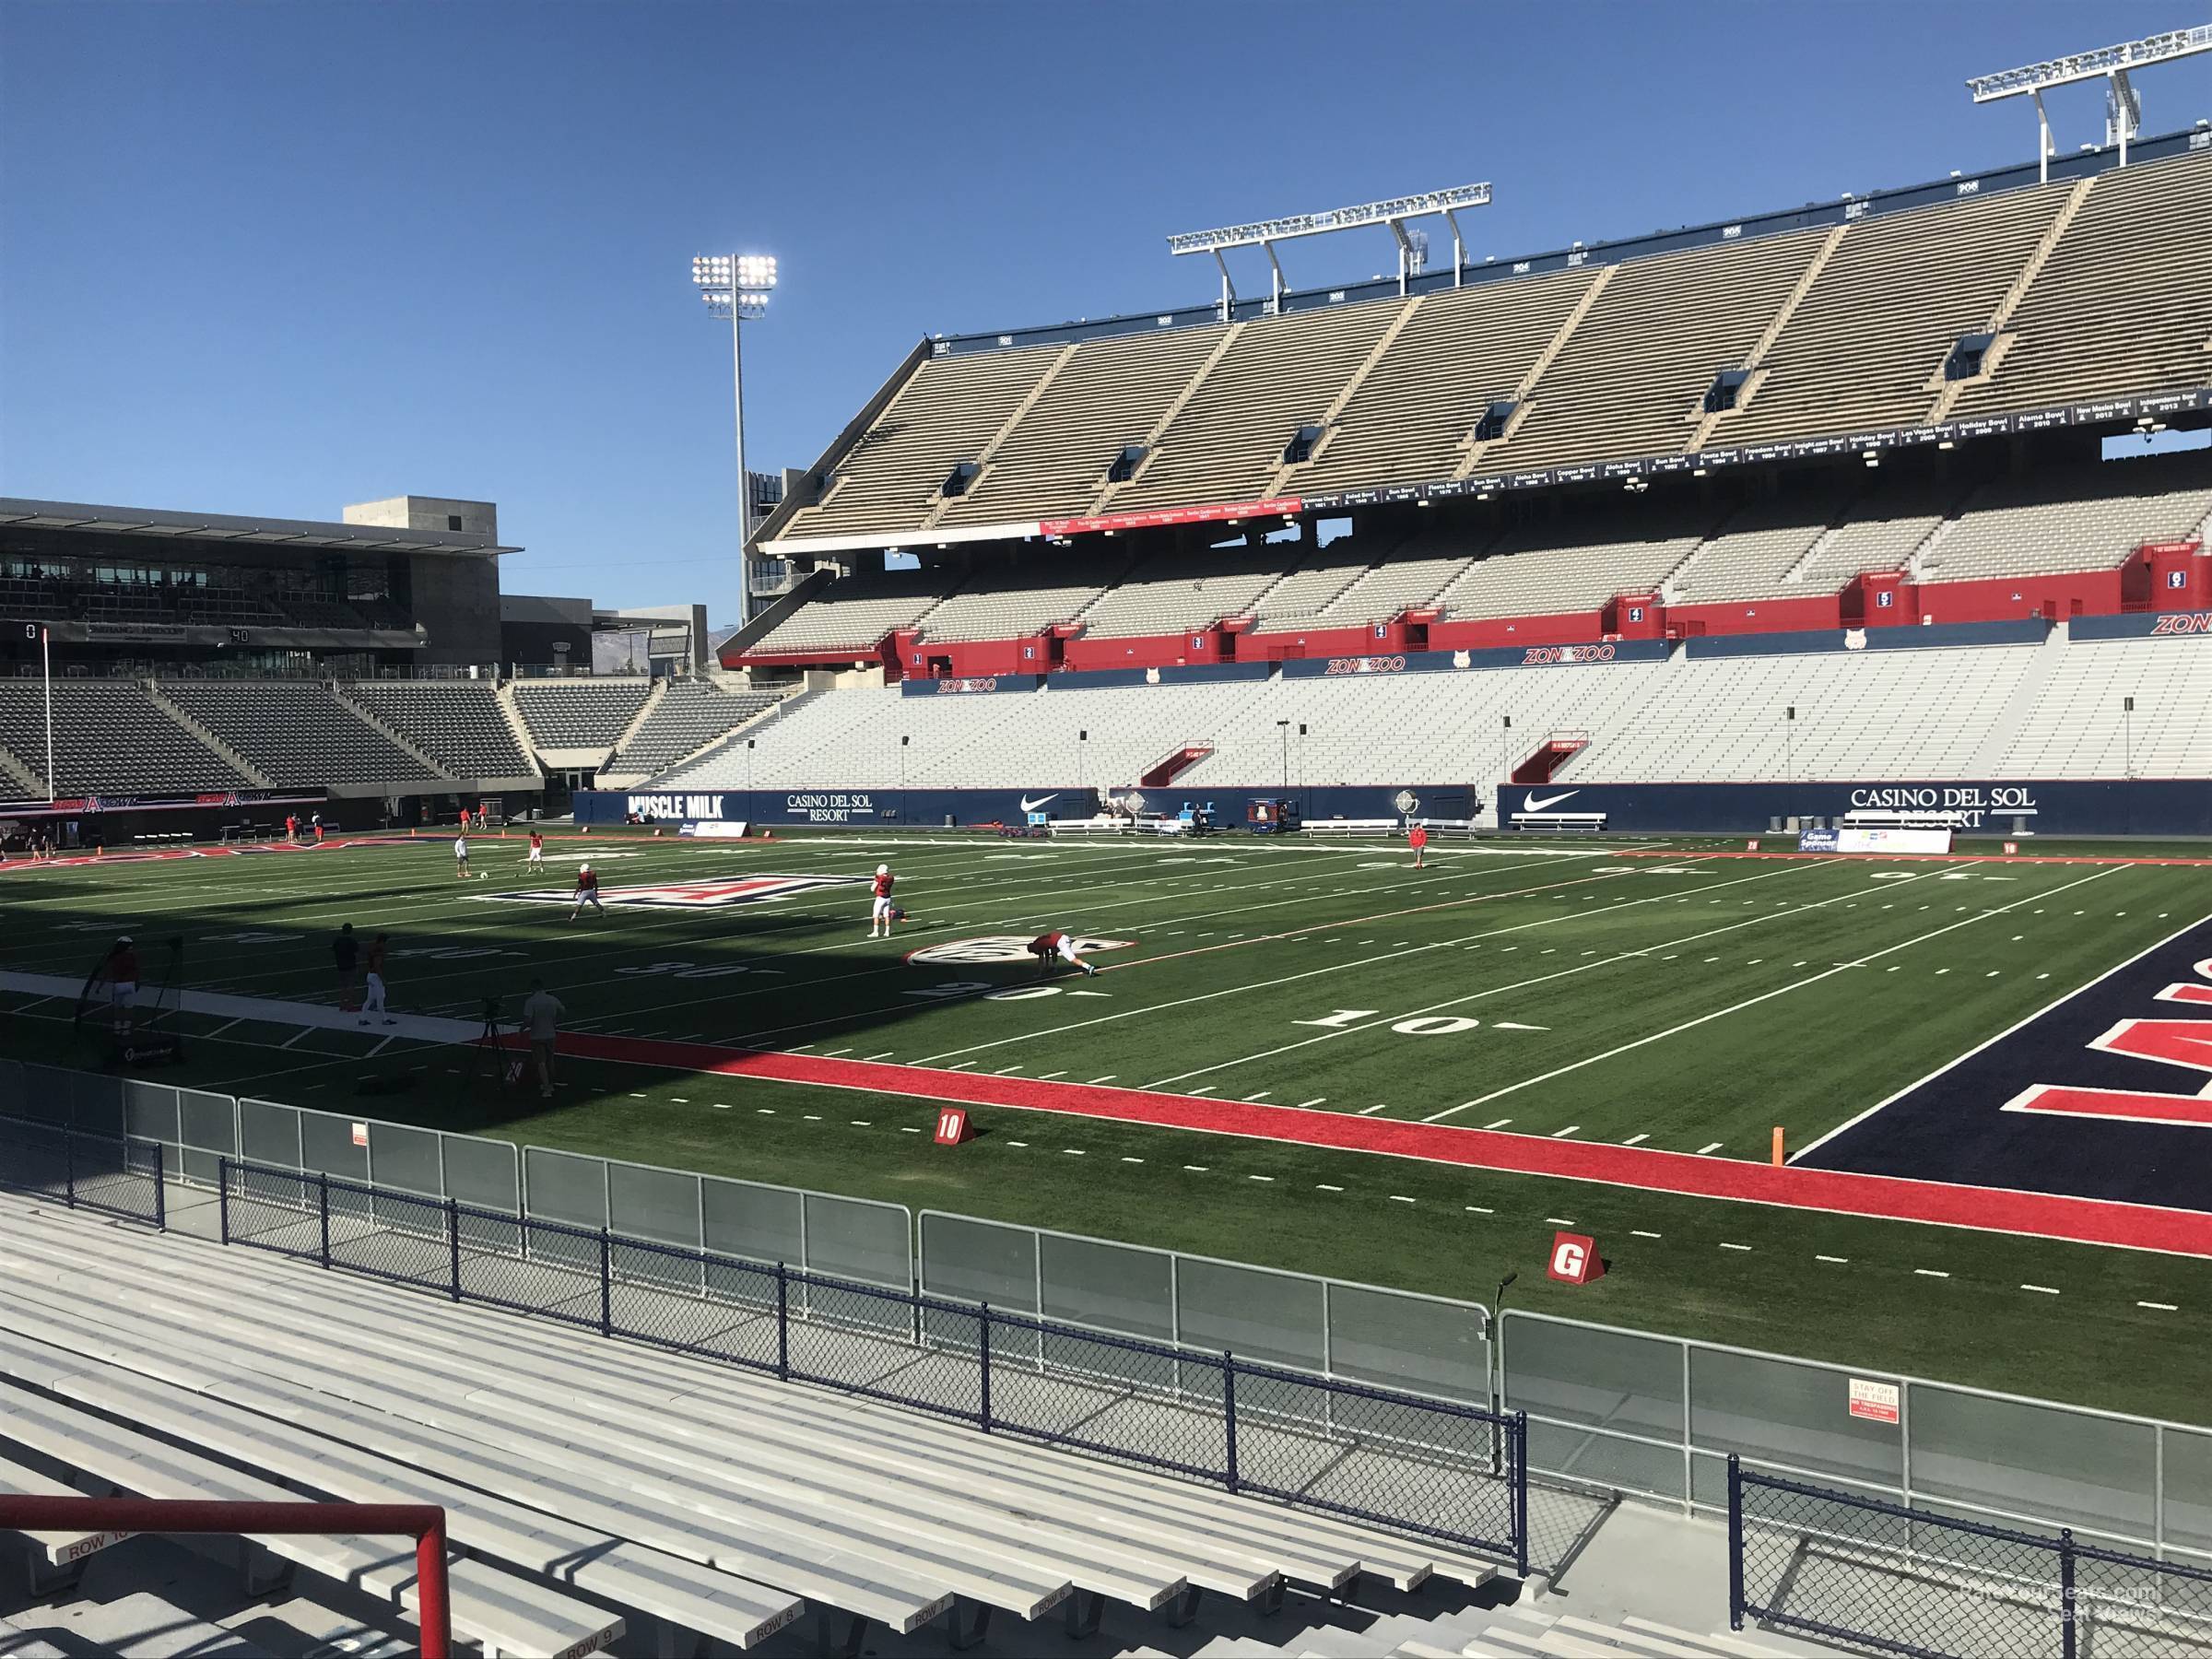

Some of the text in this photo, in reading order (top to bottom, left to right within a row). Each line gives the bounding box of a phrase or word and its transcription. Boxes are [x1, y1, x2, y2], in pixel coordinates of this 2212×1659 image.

[2139, 393, 2197, 406] Independence Bowl
[2091, 404, 2114, 413] Mexico
[2114, 400, 2132, 410] Bowl
[2159, 402, 2179, 411] 2013
[2018, 410, 2065, 422] Alamo Bowl
[2095, 411, 2113, 419] 2012
[1913, 428, 1935, 436] Vegas
[1935, 424, 1953, 433] Bowl
[1959, 418, 2008, 430] Holiday Bowl
[2033, 419, 2051, 428] 2010
[1849, 435, 1877, 443] Holiday
[1720, 450, 1737, 458] Bowl
[2172, 571, 2182, 582] 6
[1881, 593, 1888, 603] 5
[26, 624, 36, 639] 0
[232, 629, 249, 642] 40
[787, 794, 873, 807] CASINO DEL SOL
[1851, 787, 2036, 807] CASINO DEL SOL
[628, 795, 724, 818] MUSCLE MILK
[810, 808, 850, 822] RESORT
[1807, 833, 1832, 841] Game
[1801, 839, 1837, 849] Sponsor
[900, 982, 1063, 1001] 20
[1291, 1008, 1480, 1036] 10
[939, 1113, 959, 1139] 10
[1554, 1242, 1584, 1277] G
[1853, 1382, 1893, 1395] STAY OFF
[1853, 1390, 1896, 1404] THE FIELD
[68, 1535, 105, 1560] ROW
[1039, 1591, 1065, 1614] ROW 6
[1157, 1591, 1173, 1606] ROW
[915, 1599, 946, 1626] ROW 7
[756, 1609, 794, 1641] ROW 8
[567, 1630, 613, 1659] ROW 9
